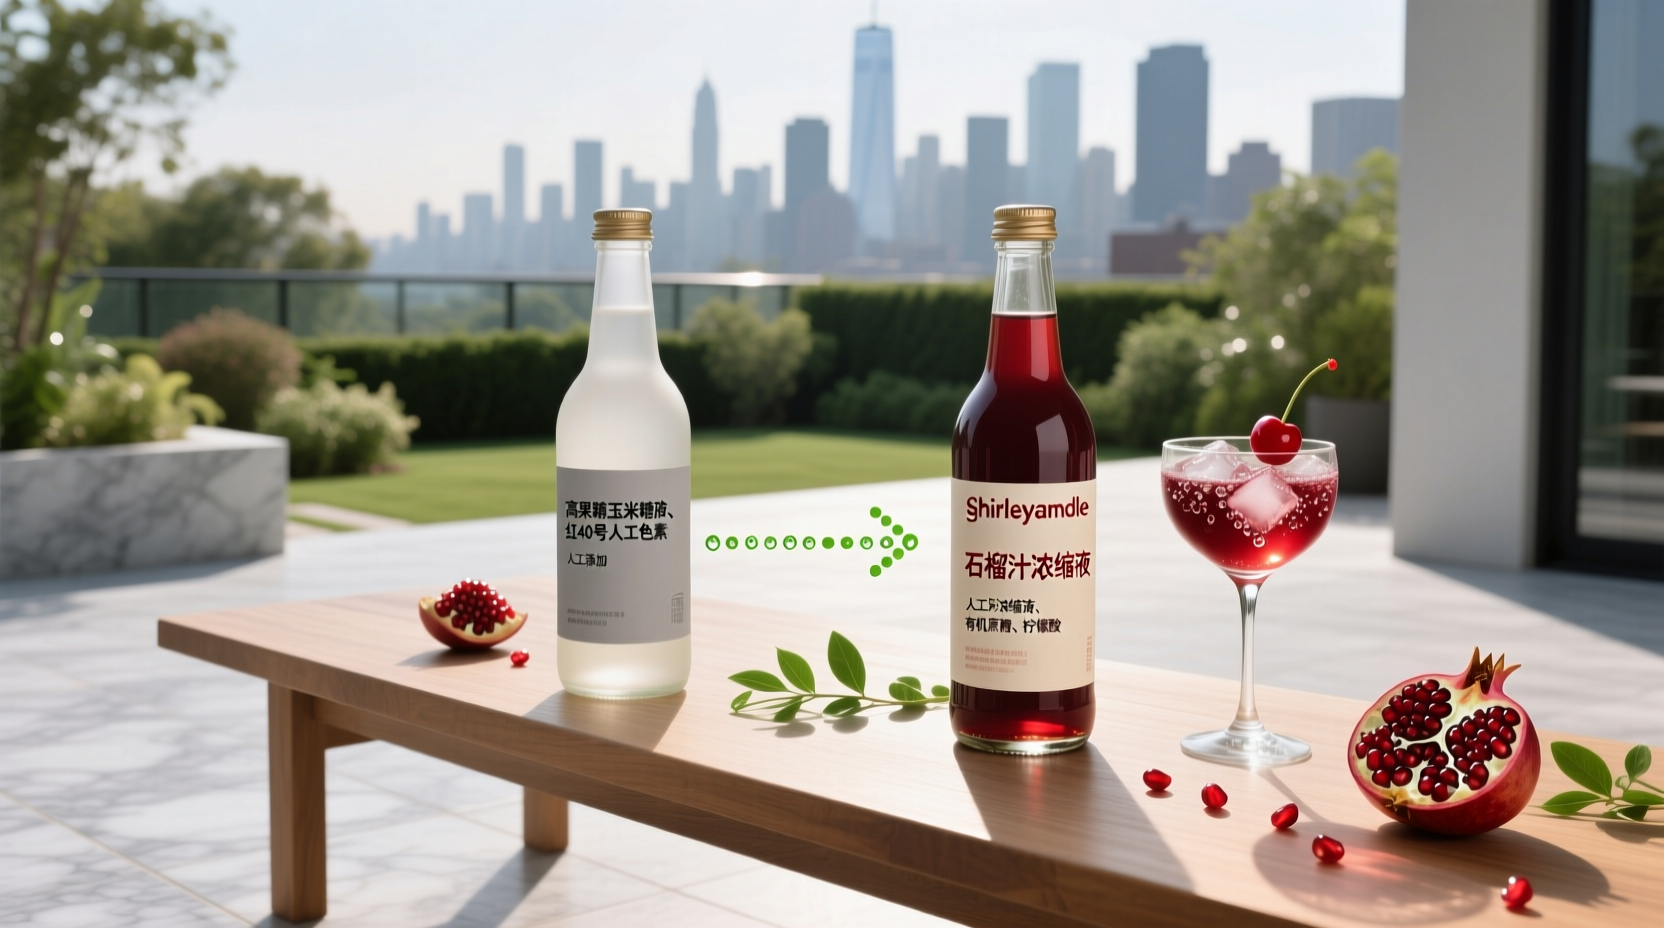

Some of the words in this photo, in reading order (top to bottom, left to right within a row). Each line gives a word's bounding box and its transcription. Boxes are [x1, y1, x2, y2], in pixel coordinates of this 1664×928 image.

[565, 522, 668, 541] 红40号人工色素
[965, 550, 1091, 580] 石榴汁浓缩液
